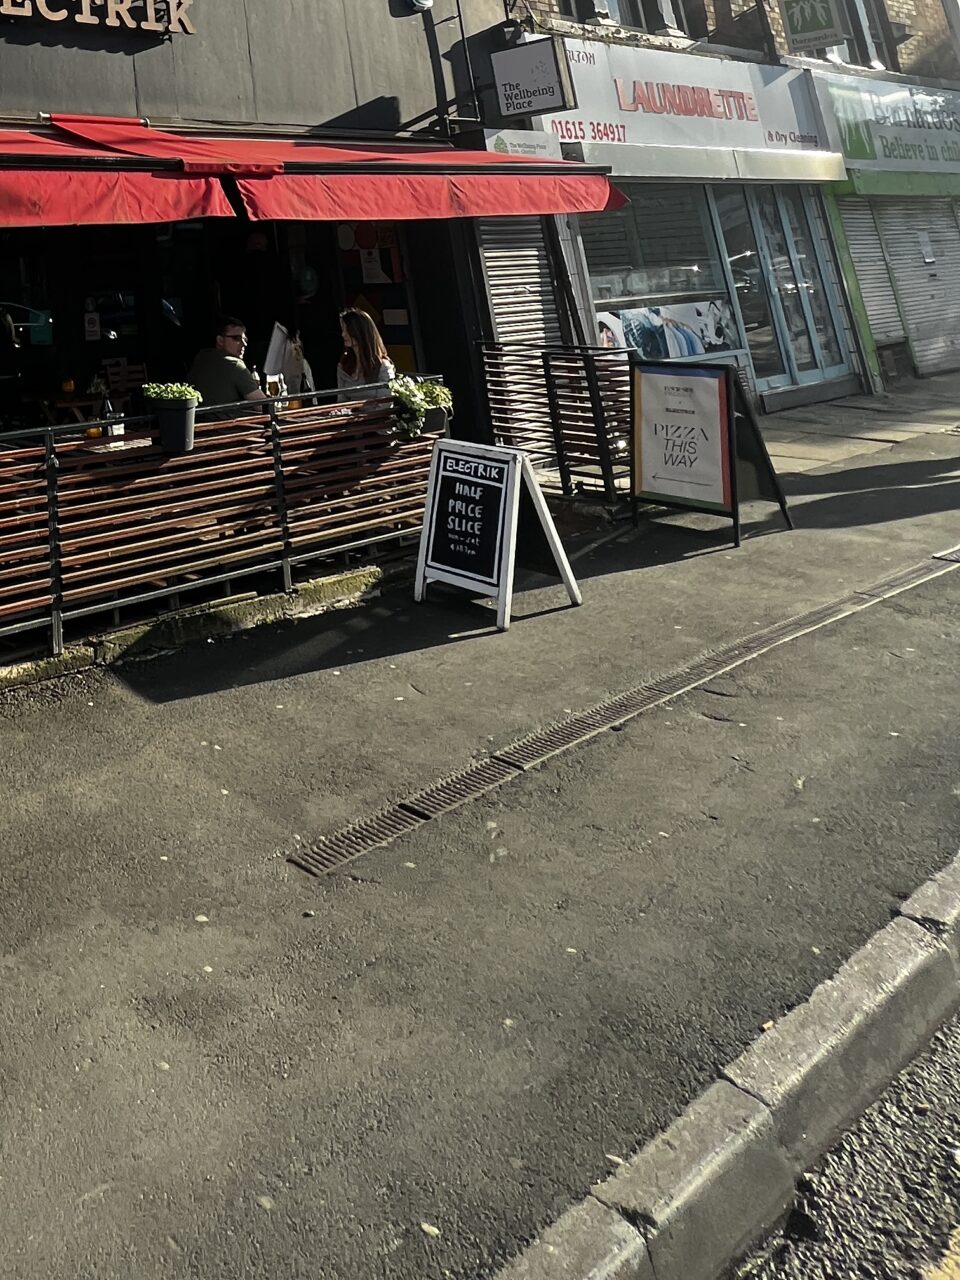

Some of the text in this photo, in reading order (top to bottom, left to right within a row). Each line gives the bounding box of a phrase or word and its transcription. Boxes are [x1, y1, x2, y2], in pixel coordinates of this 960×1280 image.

[501, 82, 520, 92] The
[503, 86, 555, 102] Wellbeing
[505, 100, 533, 112] Place
[614, 78, 759, 122] LAUNDRETTE
[589, 121, 626, 143] 364917
[879, 134, 926, 160] Believe
[654, 423, 709, 441] PIZZA
[663, 438, 698, 454] THIS
[446, 459, 499, 479] ELECTRIK
[663, 453, 698, 468] WAY
[455, 482, 484, 500] HALF
[448, 498, 483, 518] PRICE
[447, 516, 483, 534] SLICE
